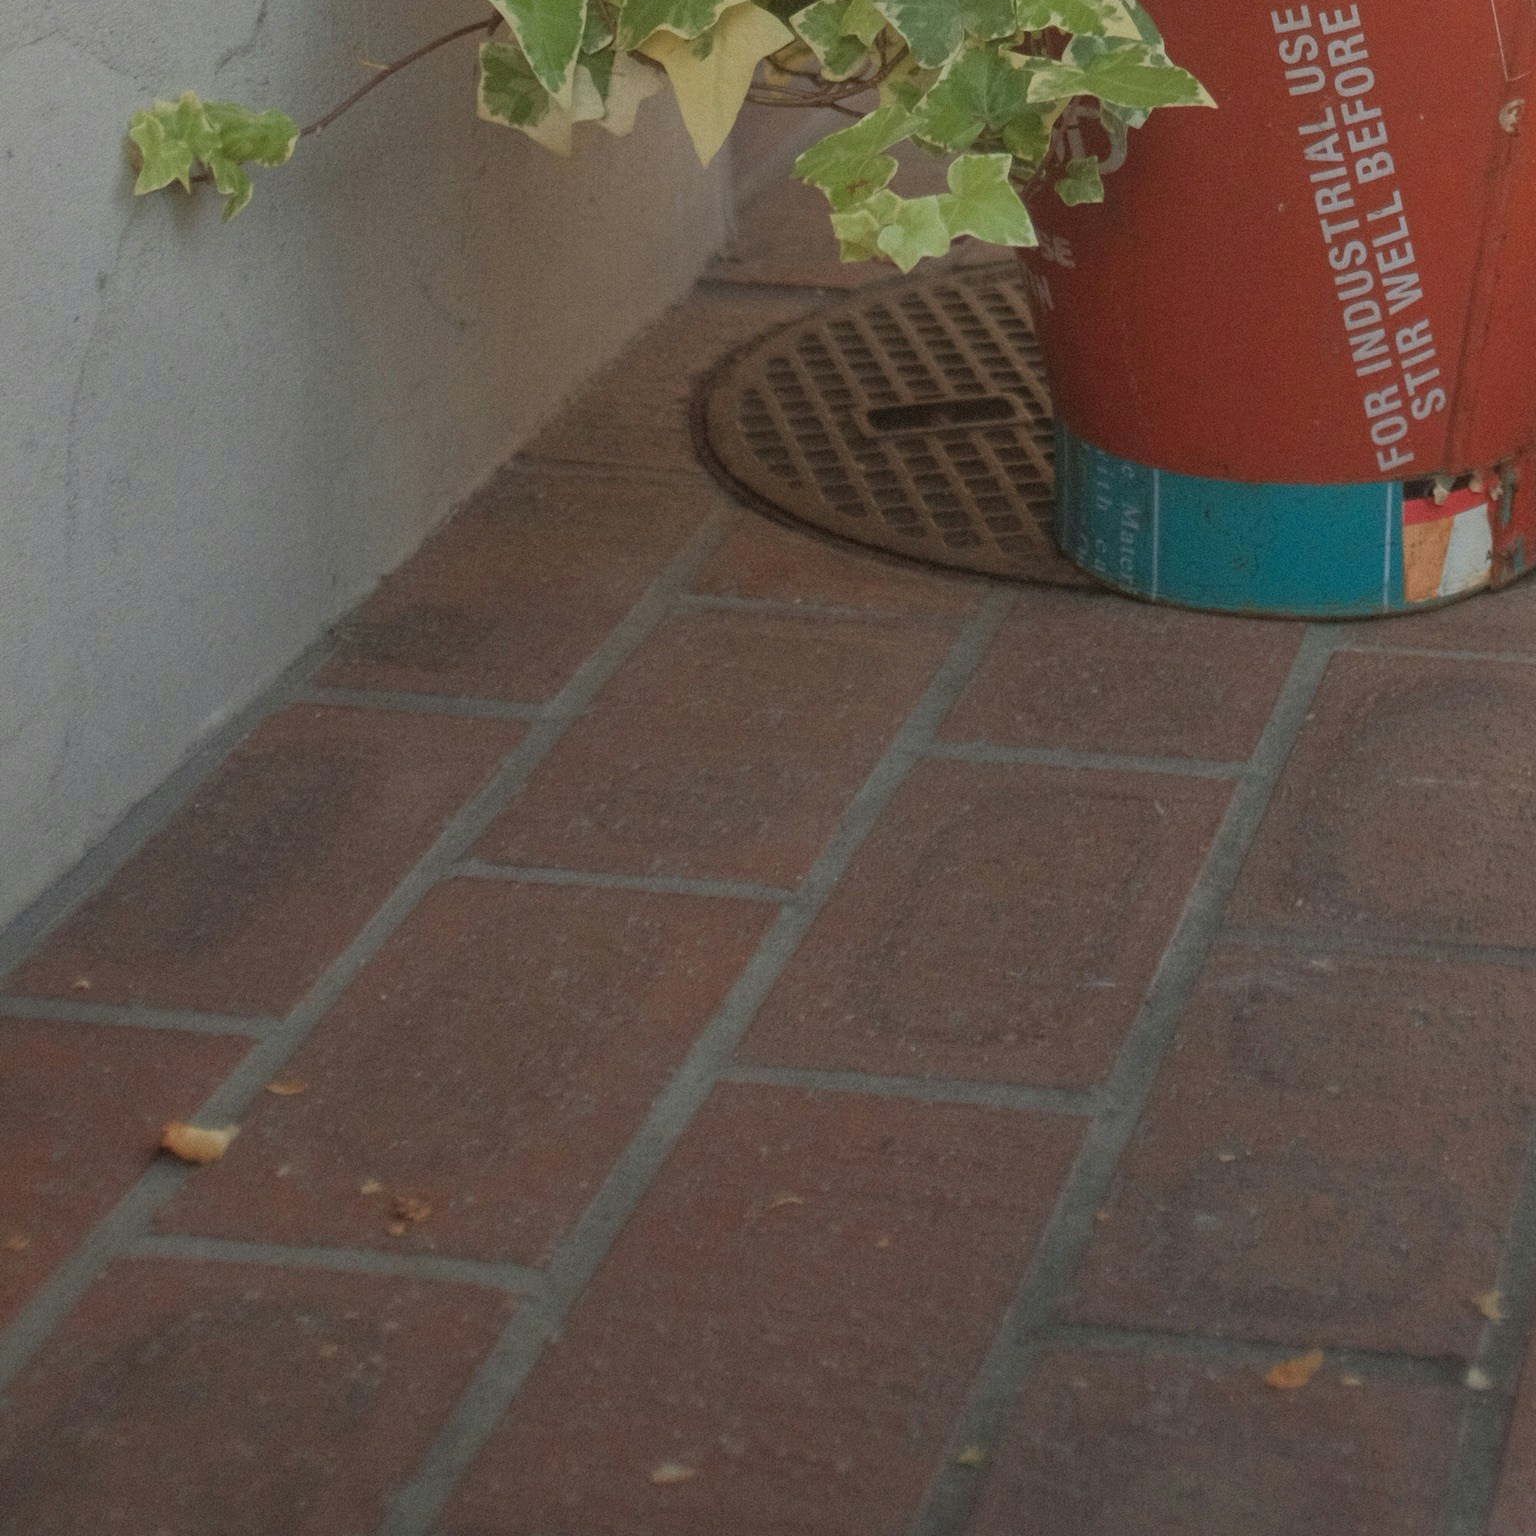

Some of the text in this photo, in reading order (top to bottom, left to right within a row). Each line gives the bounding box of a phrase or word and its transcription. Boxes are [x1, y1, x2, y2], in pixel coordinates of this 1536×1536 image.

[1270, 4, 1326, 96] USE
[1319, 4, 1395, 184] BEFORE
[1298, 106, 1392, 377] INDUSTRIAL
[1366, 189, 1423, 315] WELL
[1395, 318, 1446, 420] STIR
[1363, 384, 1414, 472] FOR
